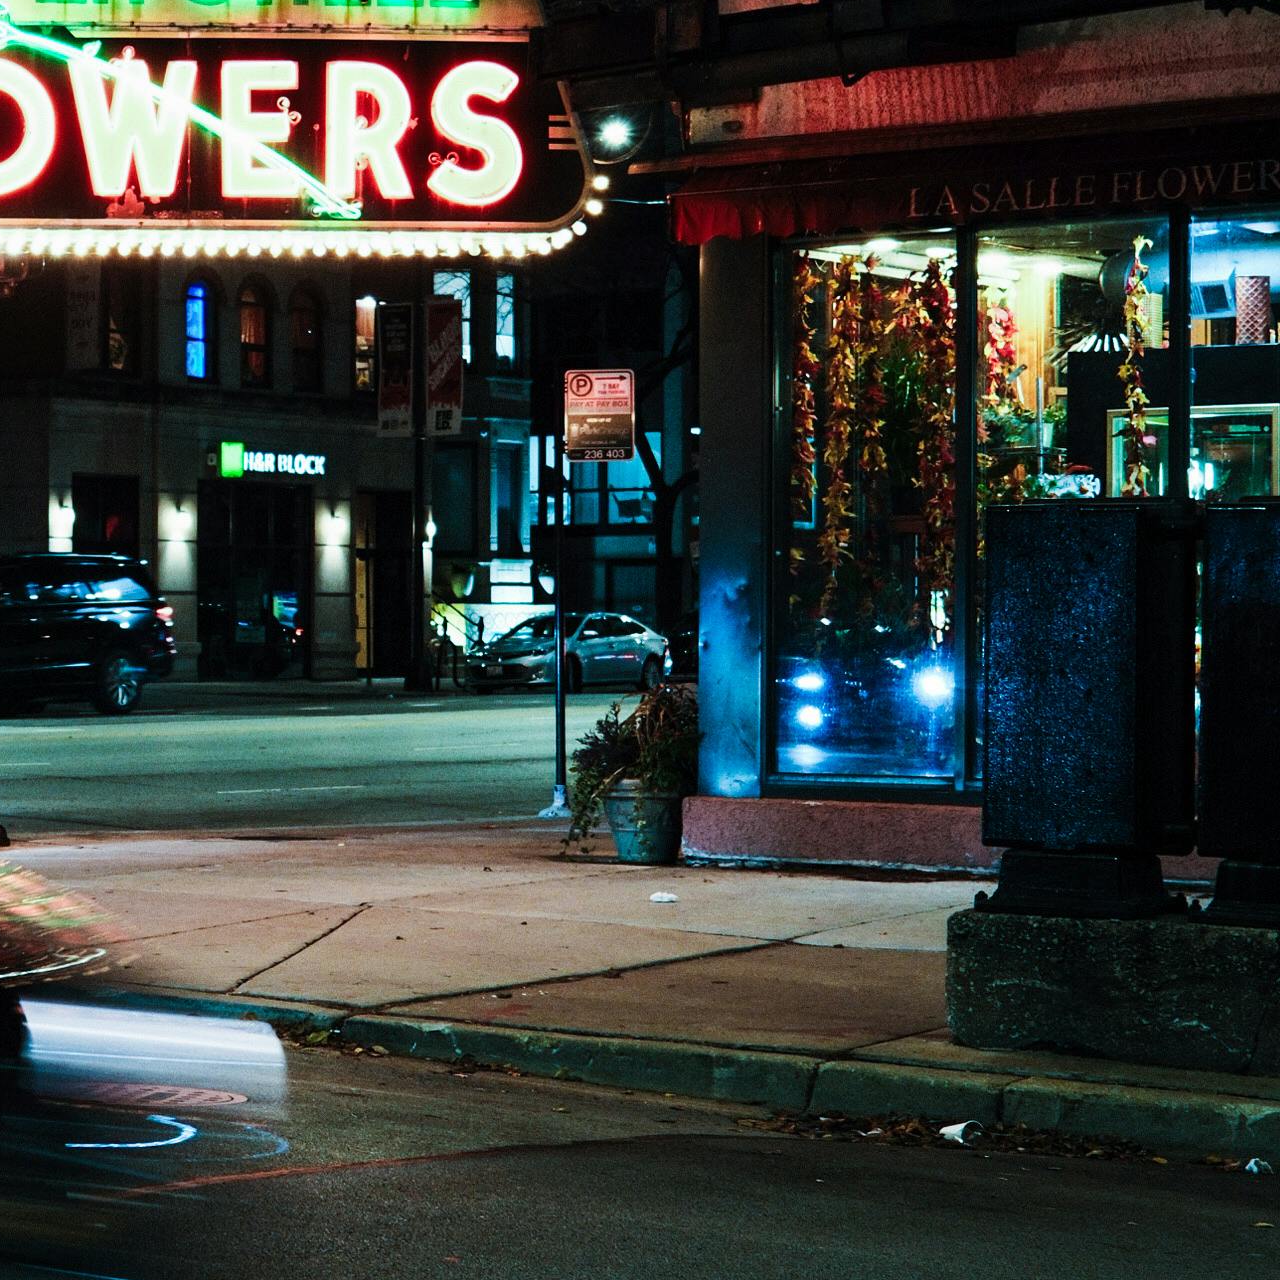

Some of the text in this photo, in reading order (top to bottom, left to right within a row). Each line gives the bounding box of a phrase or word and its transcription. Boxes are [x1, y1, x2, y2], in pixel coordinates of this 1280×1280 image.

[906, 184, 959, 219] LA
[970, 174, 1097, 215] SALLE
[243, 451, 326, 475] H&R BLOCK
[606, 449, 625, 459] 403
